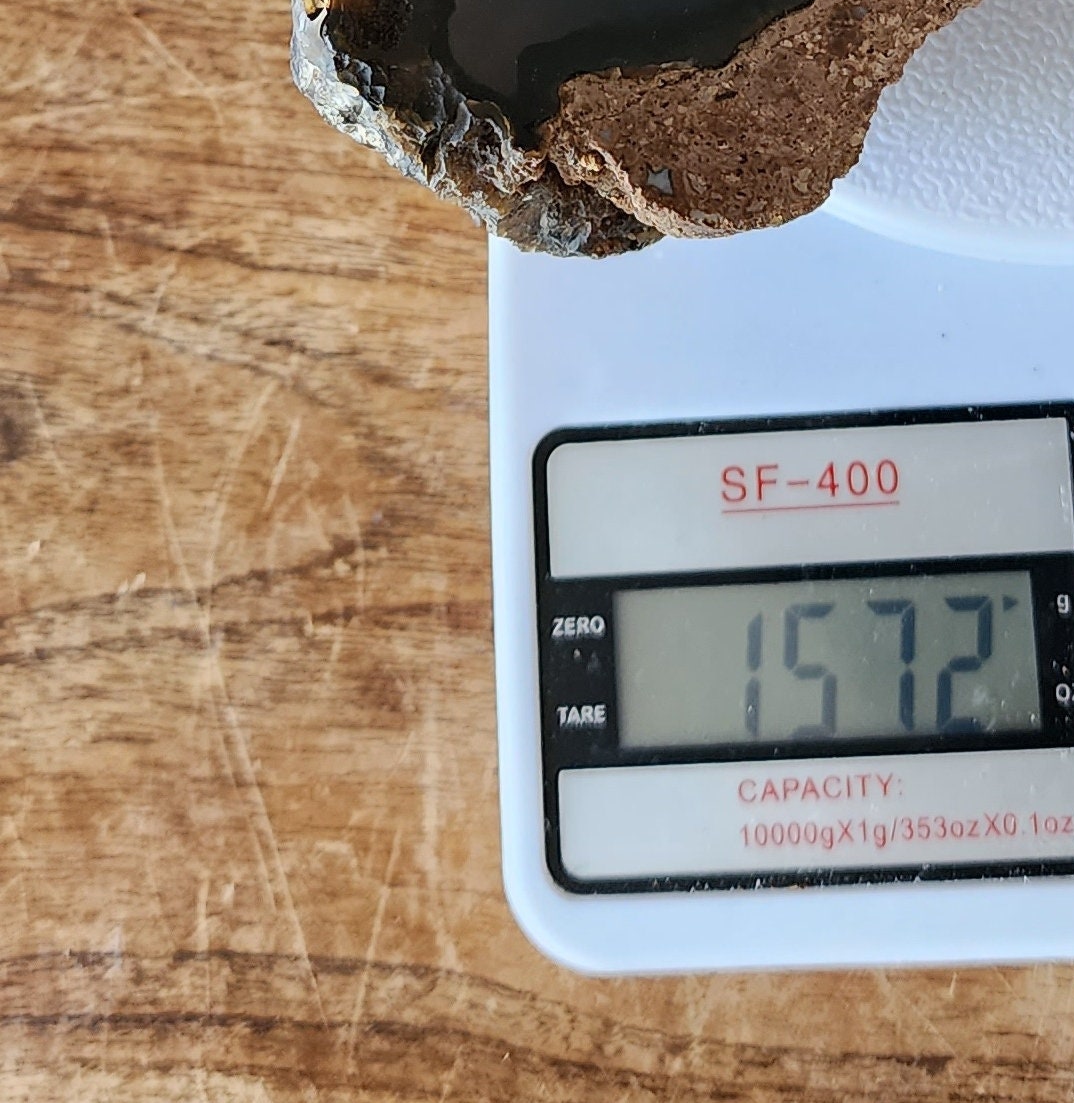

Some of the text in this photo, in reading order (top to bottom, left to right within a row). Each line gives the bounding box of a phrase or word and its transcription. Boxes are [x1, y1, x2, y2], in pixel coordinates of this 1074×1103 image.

[720, 459, 900, 503] SF-400
[1056, 594, 1070, 613] g
[552, 616, 605, 638] ZERO
[745, 596, 992, 738] 1572
[557, 705, 606, 725] TARE
[737, 773, 903, 803] CAPACITY:
